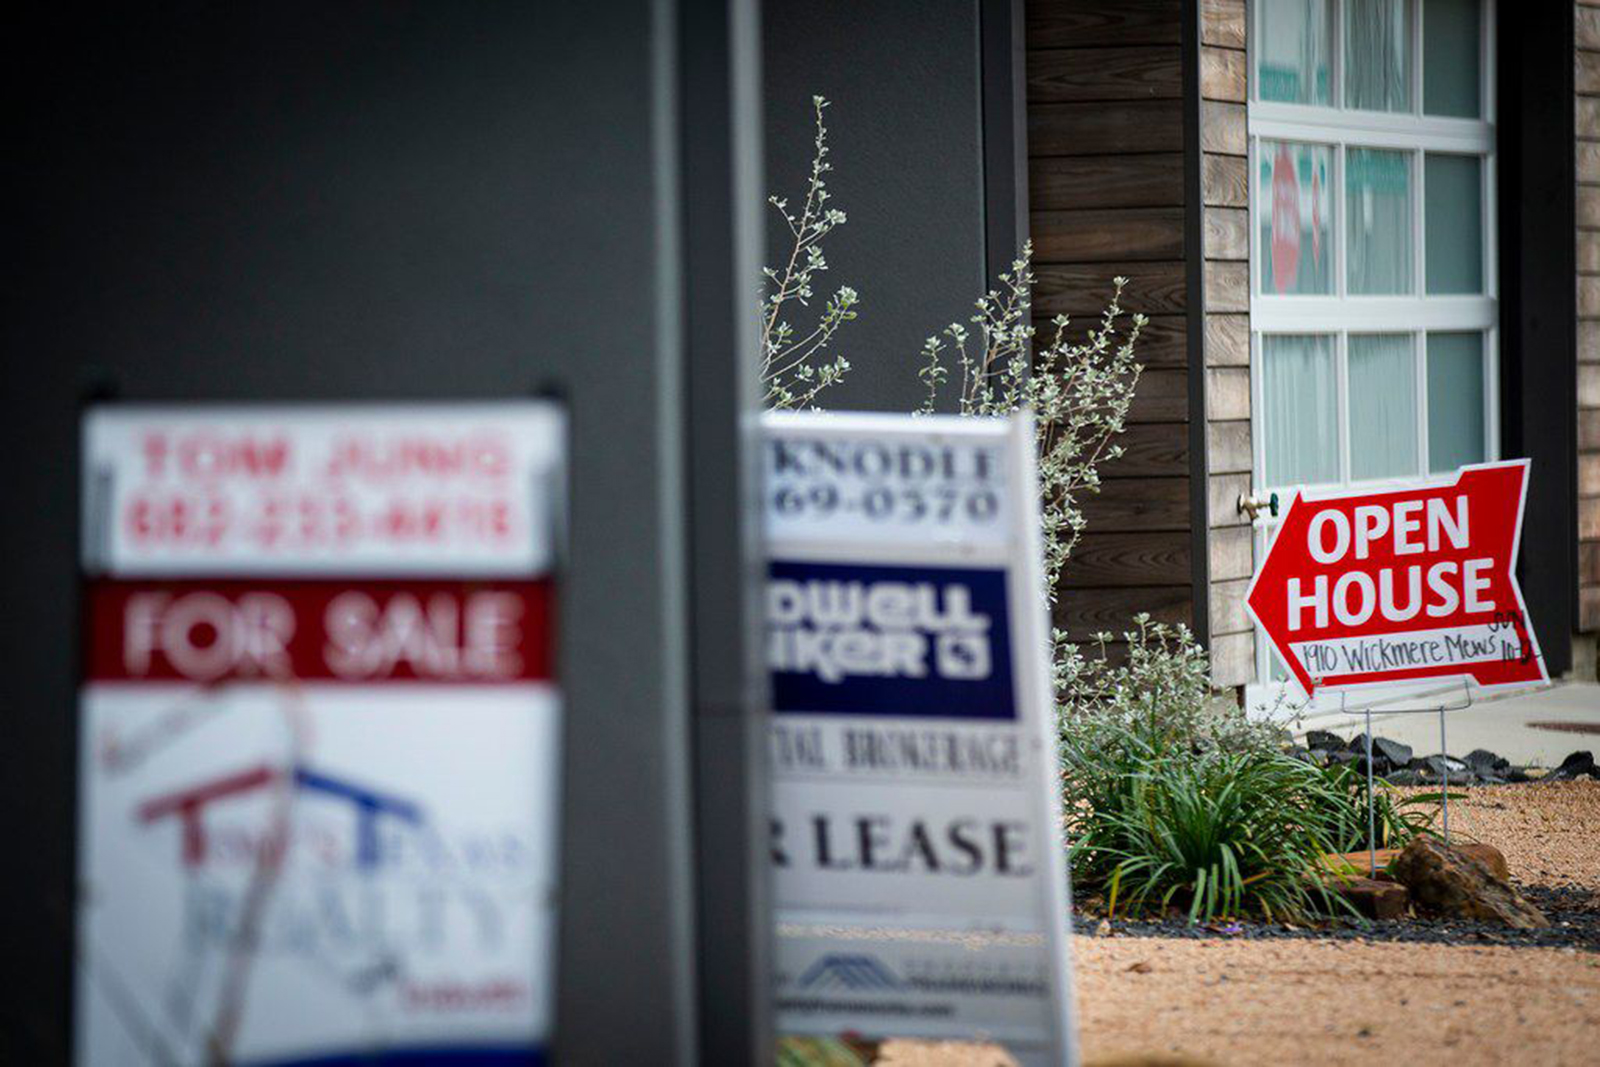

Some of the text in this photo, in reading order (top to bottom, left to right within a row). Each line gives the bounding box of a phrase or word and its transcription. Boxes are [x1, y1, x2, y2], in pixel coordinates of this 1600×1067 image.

[140, 433, 293, 481] TOM
[1307, 495, 1470, 565] OPEN
[1287, 557, 1496, 632] HOUSE
[123, 592, 523, 681] FOR SALE
[1303, 632, 1497, 672] 1910 Wickmere Mews
[811, 812, 1034, 877] LEASE
